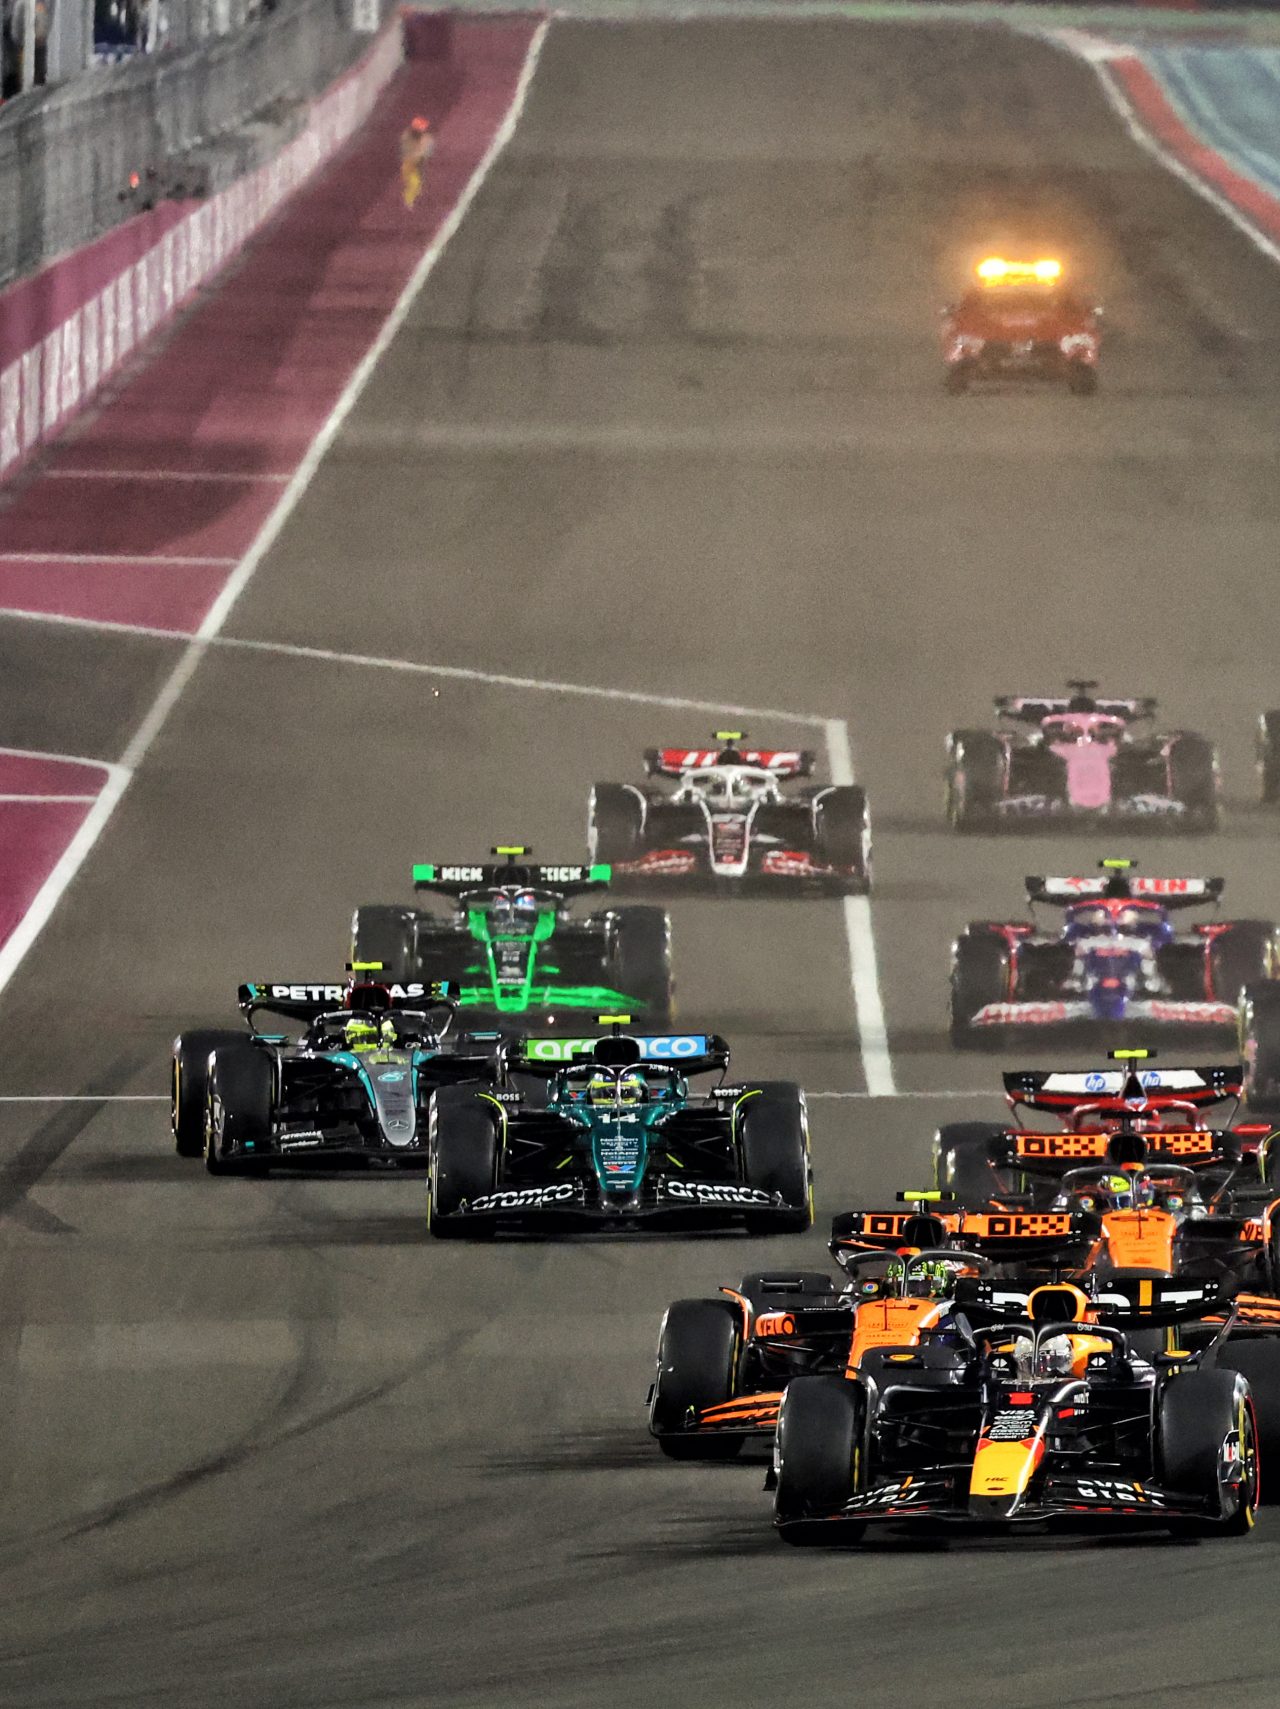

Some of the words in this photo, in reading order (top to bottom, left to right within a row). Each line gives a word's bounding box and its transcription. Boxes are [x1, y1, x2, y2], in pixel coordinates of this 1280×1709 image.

[441, 866, 484, 882] KICK
[271, 983, 425, 1001] PETRAS
[1086, 1074, 1106, 1091] hp
[496, 1092, 521, 1102] BOSS
[713, 1088, 740, 1097] BOSS
[597, 1113, 640, 1124] 14
[471, 1183, 574, 1211] aramco
[667, 1181, 771, 1204] aramco
[987, 1215, 1065, 1236] OKX
